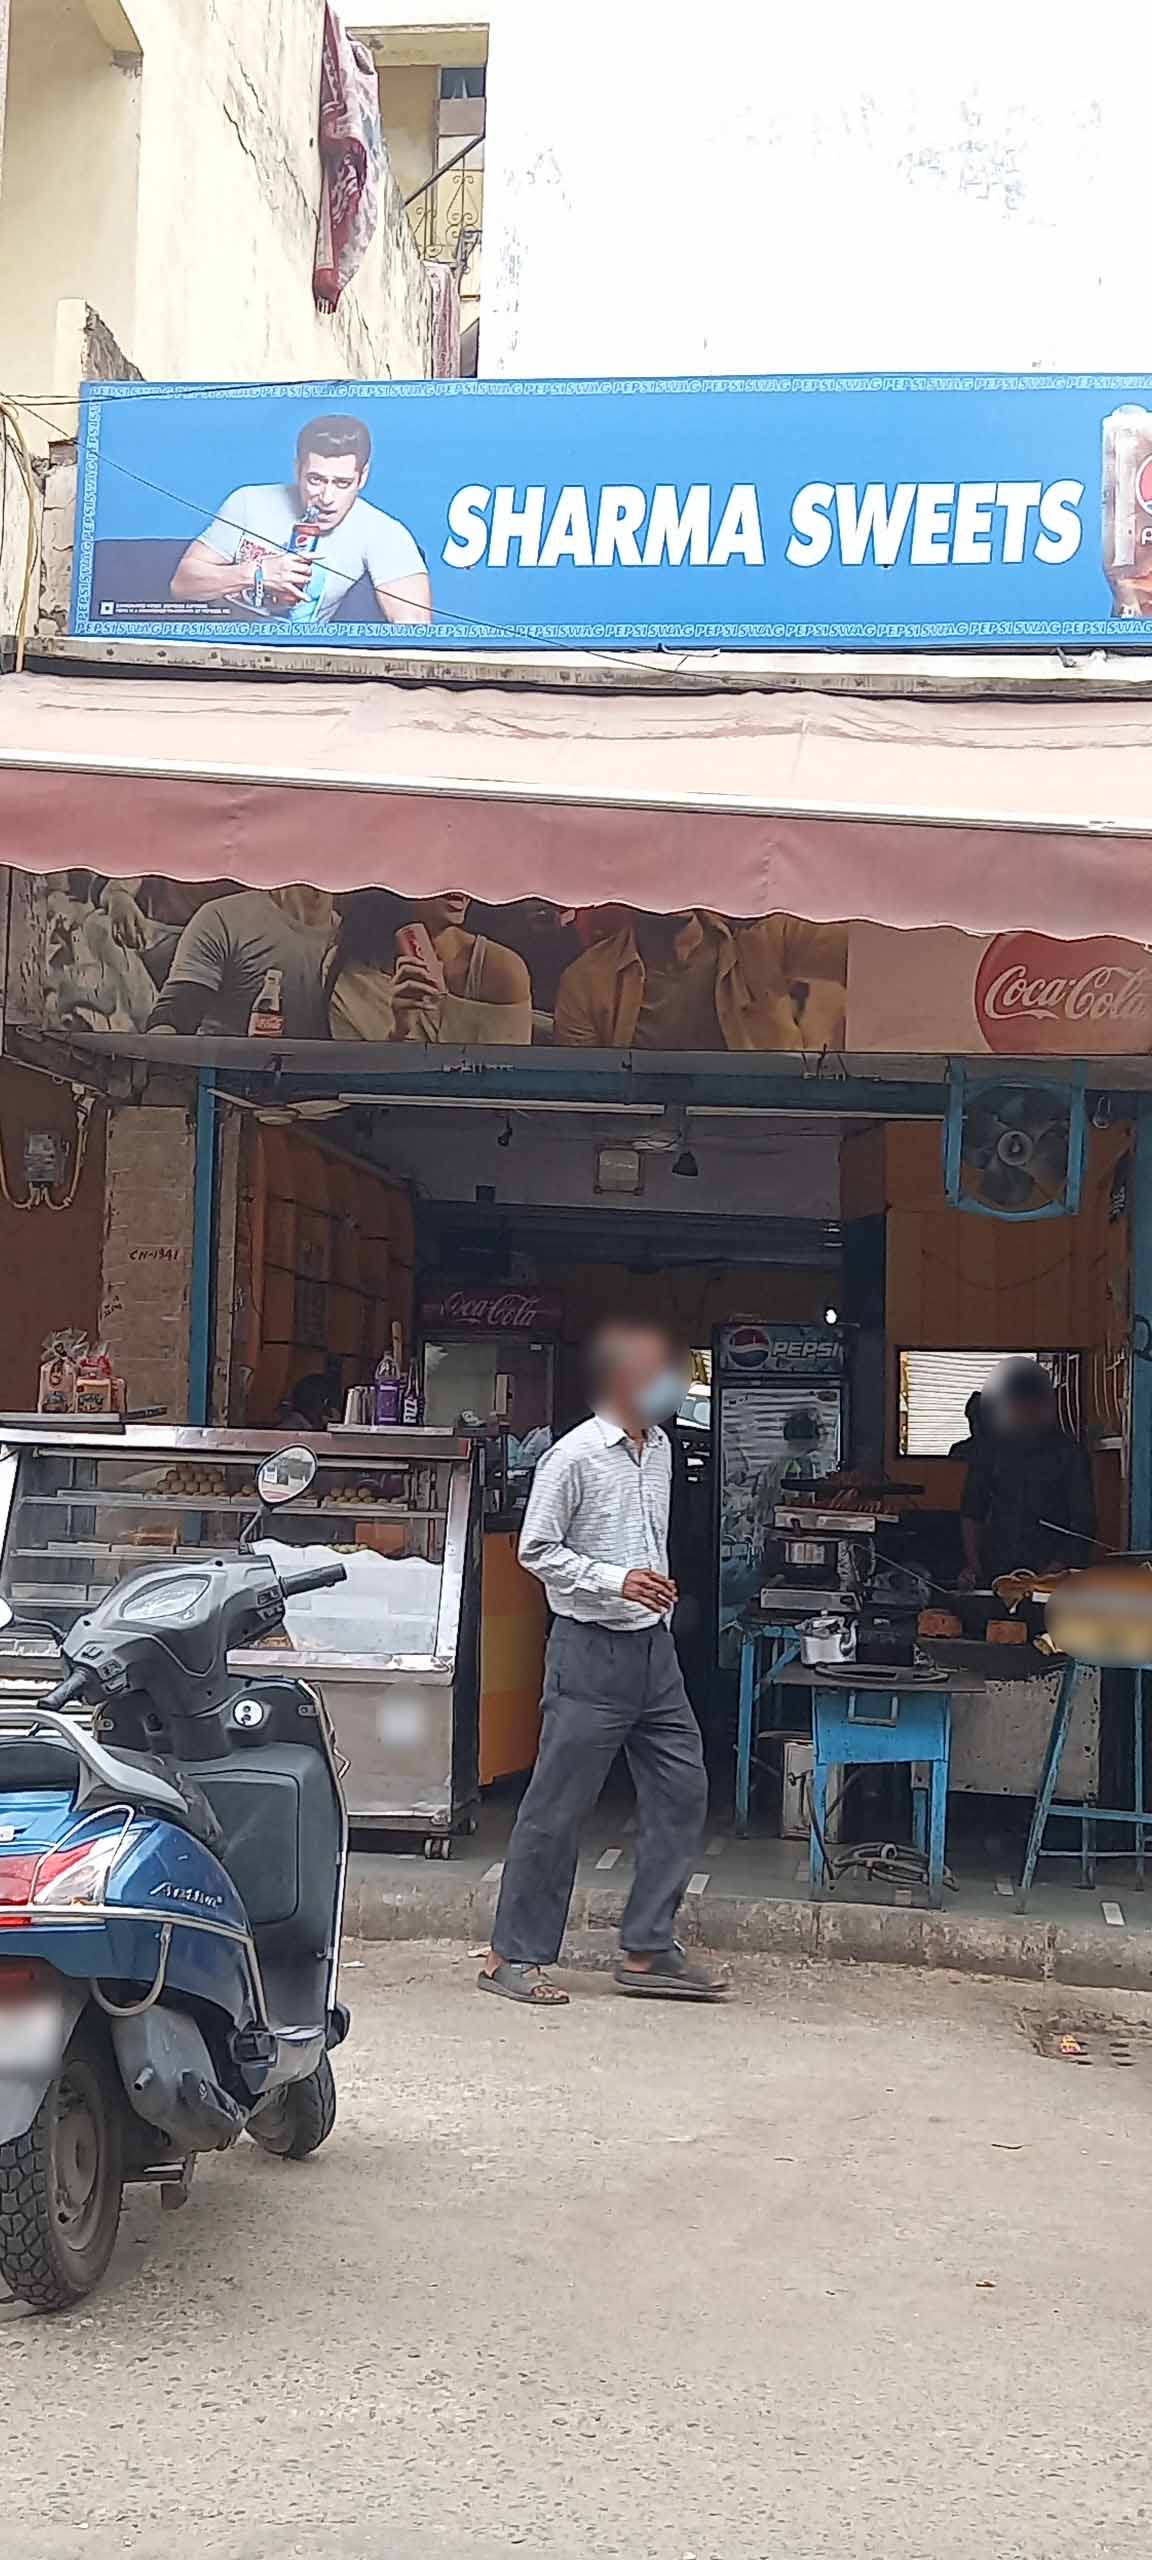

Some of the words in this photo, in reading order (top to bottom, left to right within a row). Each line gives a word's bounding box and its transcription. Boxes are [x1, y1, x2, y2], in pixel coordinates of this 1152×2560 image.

[261, 384, 300, 398] PEPSI
[349, 383, 390, 397] PEPSI
[435, 382, 478, 396] PEPSI
[523, 381, 567, 395] PEPSI
[567, 381, 611, 395] SWAG
[702, 379, 745, 393] PEPSI
[745, 379, 791, 392] SWAG
[792, 378, 835, 392] PEPSI
[883, 377, 926, 391] PEPSI
[1111, 376, 1152, 390] SWA
[441, 483, 766, 569] SHARMA
[785, 479, 1085, 567] SWEETS
[75, 622, 117, 634] PEPSI
[116, 622, 162, 635] SWAG
[162, 622, 202, 635] PEPSI
[203, 622, 249, 636] SWAG
[250, 622, 291, 636] PEPSI
[292, 623, 337, 636] SWAG
[337, 623, 380, 637] PEPSI
[427, 624, 469, 638] PEPSI
[558, 624, 604, 638] SWAG
[605, 624, 648, 638] PEPSI
[648, 624, 694, 638] SWAG
[695, 624, 738, 638] PEPSI
[738, 624, 784, 638] SWAG
[785, 624, 829, 637] PEPSI
[829, 624, 876, 637] SWAG
[876, 624, 920, 637] PEPSI
[920, 622, 968, 637] SWAG
[969, 622, 1013, 636] PEPSI
[1013, 622, 1061, 635] SWAG
[1062, 621, 1107, 635] PEPSI
[984, 965, 1149, 1021] Coca-Cola
[440, 1290, 538, 1327] Coca-Cola
[771, 1341, 840, 1357] PEPSI
